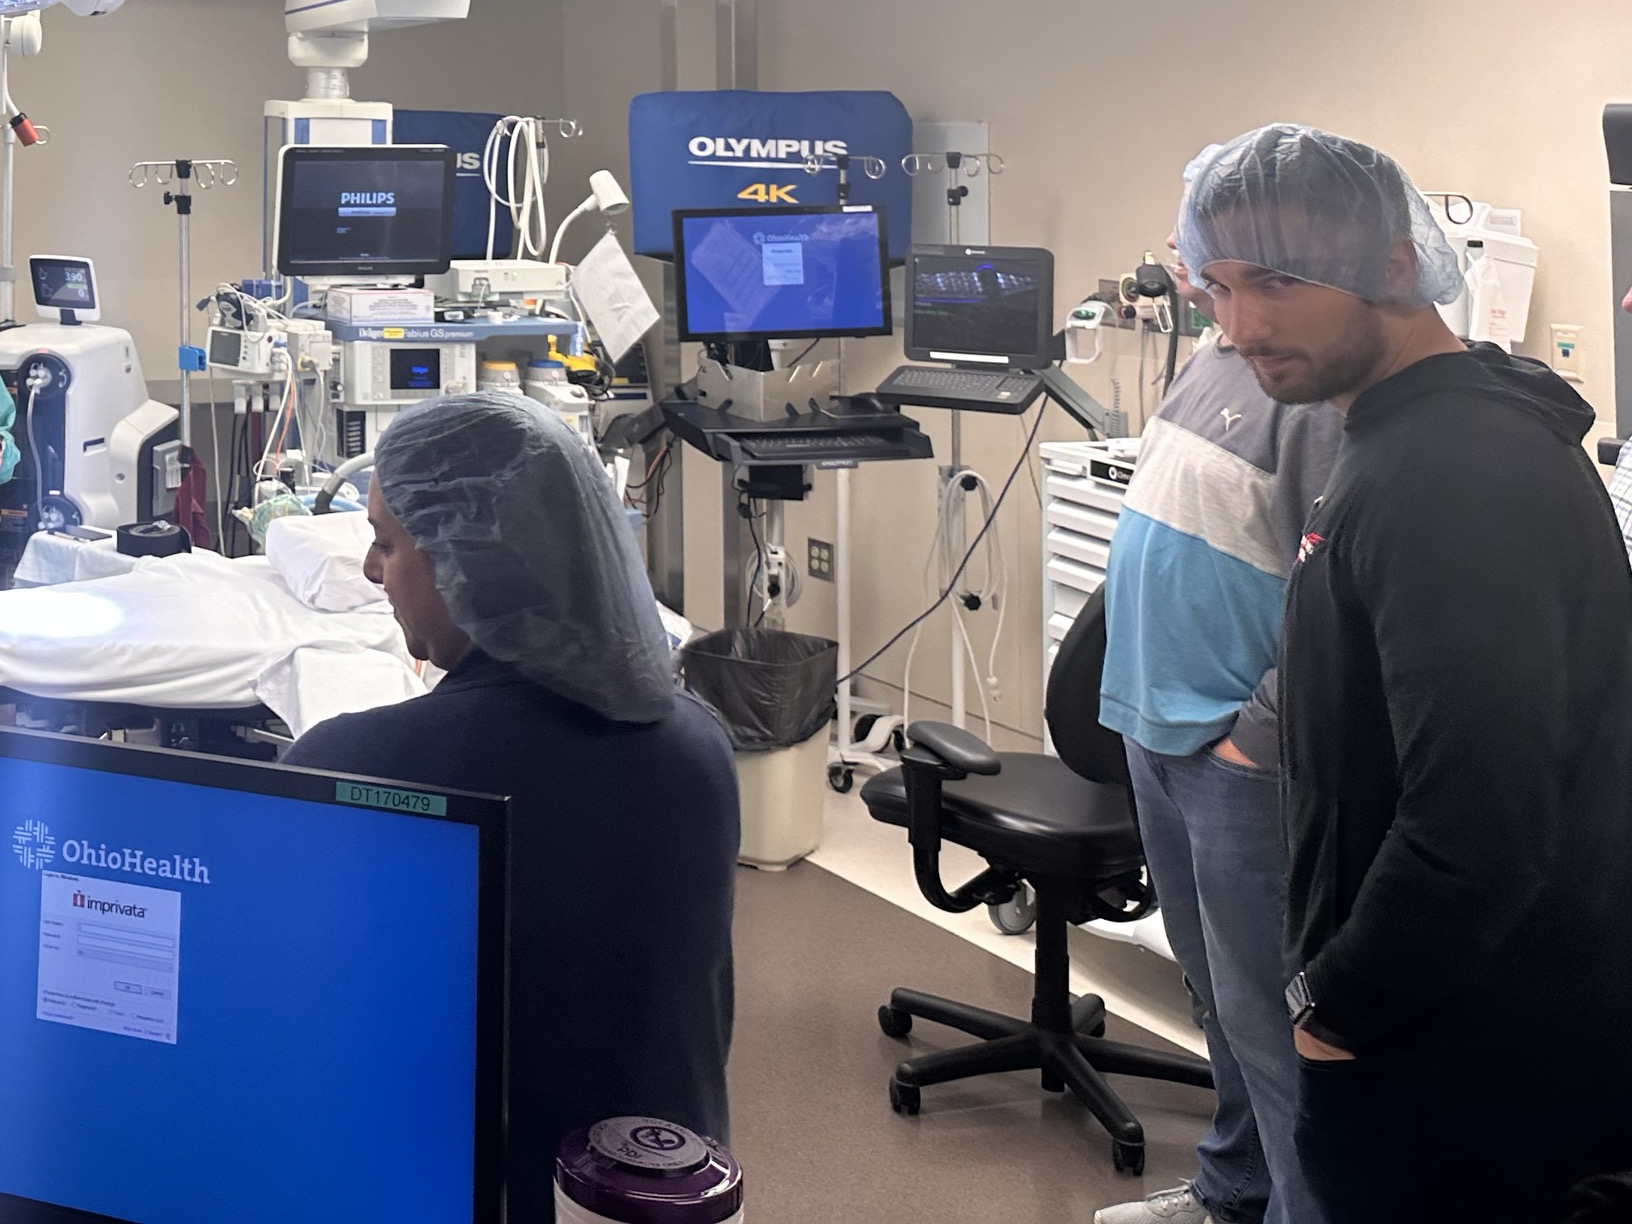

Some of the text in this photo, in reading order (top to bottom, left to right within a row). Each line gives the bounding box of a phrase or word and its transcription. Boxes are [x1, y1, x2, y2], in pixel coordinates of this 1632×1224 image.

[688, 136, 849, 161] OLYMPUS
[340, 192, 395, 205] PHILIPS
[737, 183, 799, 204] 4K
[349, 786, 431, 812] DT170479
[62, 839, 211, 884] OhioHealth
[87, 894, 146, 918] imprivata
